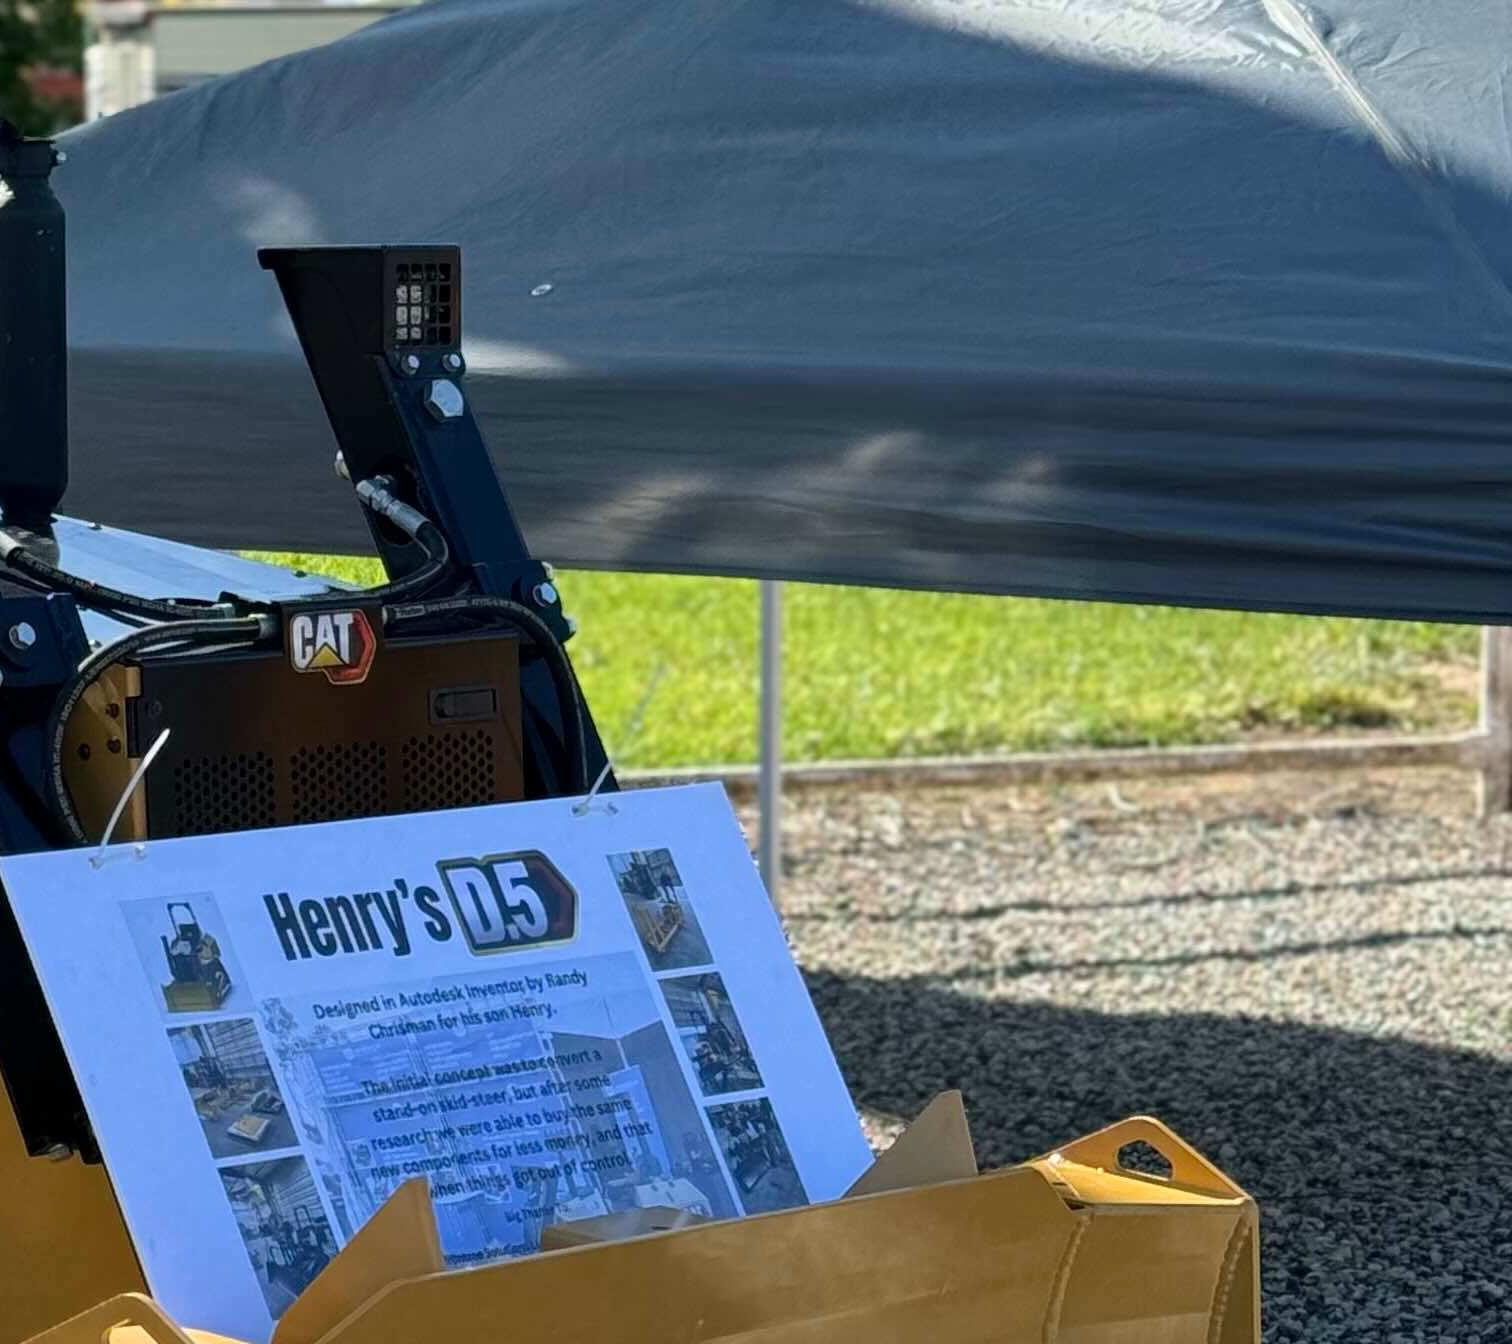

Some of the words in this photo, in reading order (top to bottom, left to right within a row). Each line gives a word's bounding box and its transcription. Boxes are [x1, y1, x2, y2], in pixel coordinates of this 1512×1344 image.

[293, 613, 354, 670] CAT
[262, 878, 453, 961] Henry's
[313, 995, 380, 1019] Designed
[381, 993, 397, 1010] in
[399, 985, 465, 1007] Autodesk
[524, 975, 544, 994] by
[544, 968, 588, 989] Randy
[368, 1018, 437, 1040] Chrisman
[437, 1012, 458, 1031] for
[460, 1008, 482, 1026] his
[485, 1006, 508, 1024] son
[507, 1001, 557, 1020] Henry.
[593, 1049, 603, 1061] a
[372, 1101, 437, 1123] stand-on
[512, 1083, 538, 1102] but
[574, 1074, 611, 1092] some
[458, 1120, 493, 1137] were
[494, 1113, 524, 1132] able
[526, 1111, 542, 1126] to
[571, 1102, 595, 1118] the
[597, 1098, 633, 1116] same
[491, 1143, 513, 1161] for
[515, 1138, 543, 1157] less
[598, 1124, 622, 1143] and
[623, 1120, 653, 1139] that
[564, 1158, 579, 1176] of
